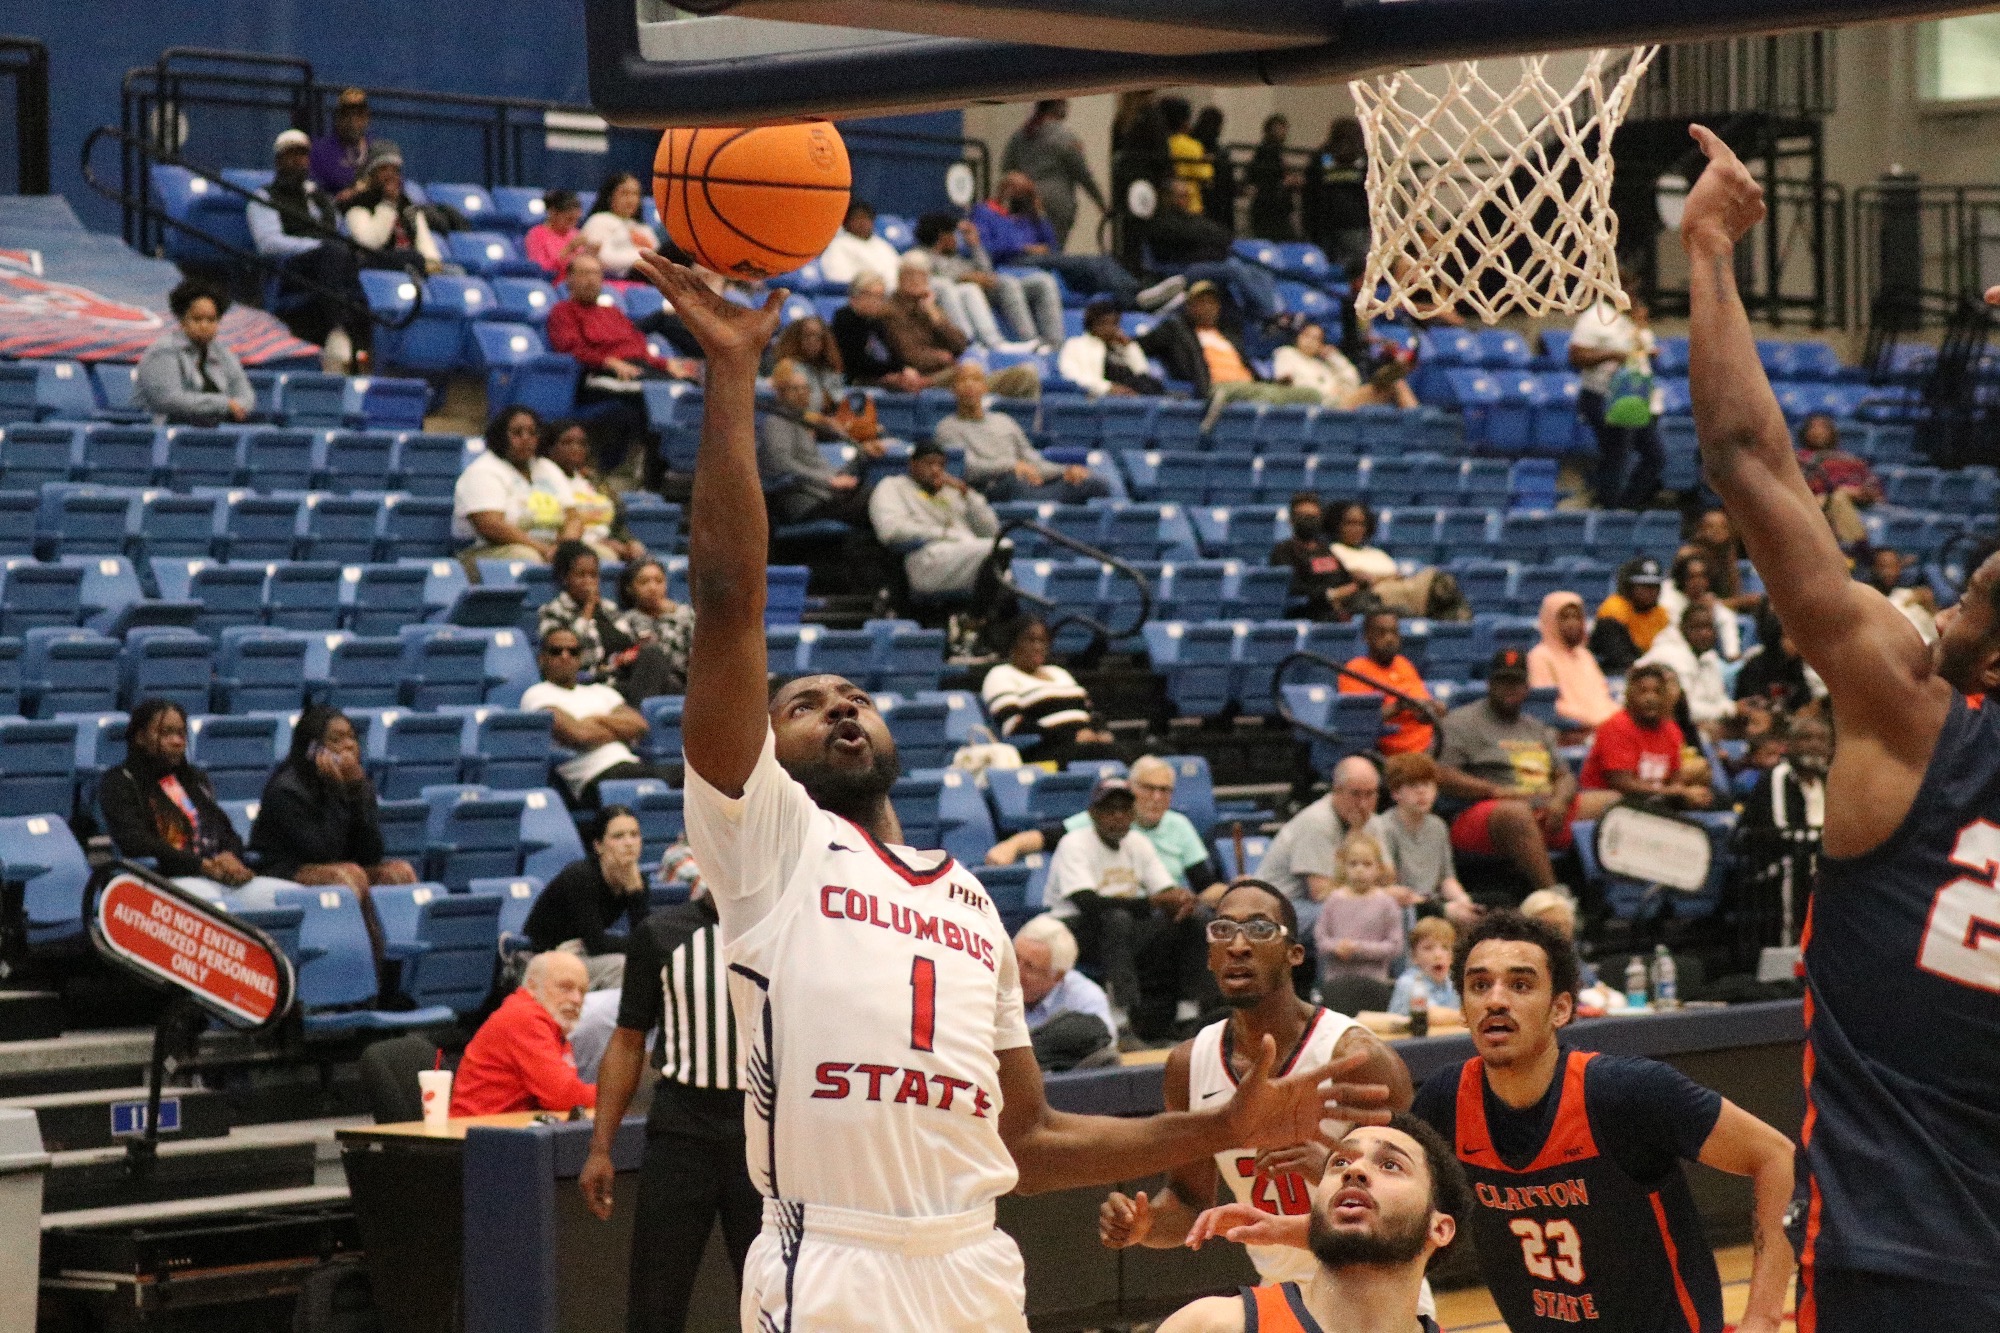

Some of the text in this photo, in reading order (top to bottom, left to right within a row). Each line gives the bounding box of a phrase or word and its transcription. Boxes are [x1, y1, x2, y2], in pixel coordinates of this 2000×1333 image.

[820, 884, 995, 973] COLUMBUS
[948, 882, 989, 914] PBC
[113, 903, 277, 998] AUTHORIZED PERSONNEL
[151, 900, 247, 961] DO NOT ENTER
[171, 953, 209, 983] ONLY
[909, 954, 936, 1054] 1
[1475, 1178, 1590, 1211] CLAYTON
[1508, 1217, 1586, 1285] 23
[1532, 1289, 1600, 1323] STATE
